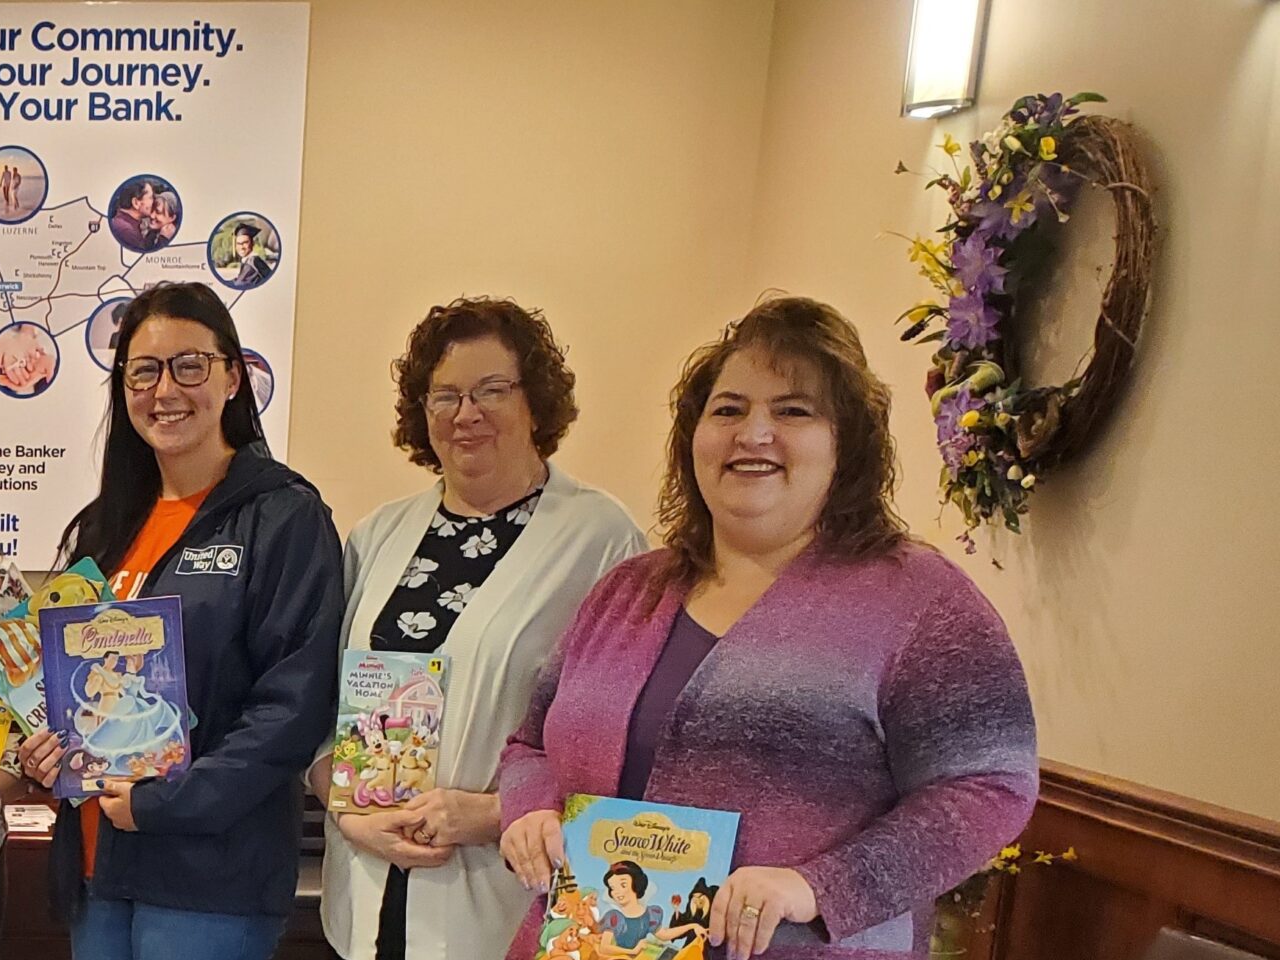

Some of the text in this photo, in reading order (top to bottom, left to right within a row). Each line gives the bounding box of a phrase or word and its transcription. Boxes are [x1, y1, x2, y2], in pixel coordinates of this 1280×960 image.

[31, 21, 243, 57] Community.
[61, 57, 210, 92] Journey.
[89, 92, 182, 121] Bank.
[146, 256, 182, 264] MONROE
[15, 445, 65, 458] Banker
[19, 462, 45, 474] and
[184, 549, 214, 560] United
[193, 561, 211, 570] Way
[81, 625, 153, 653] Cinderella
[431, 661, 441, 671] $1
[350, 672, 392, 680] MINNIE'S
[347, 680, 393, 688] VACATION
[355, 689, 384, 698] HOME
[604, 827, 691, 854] Snow White
